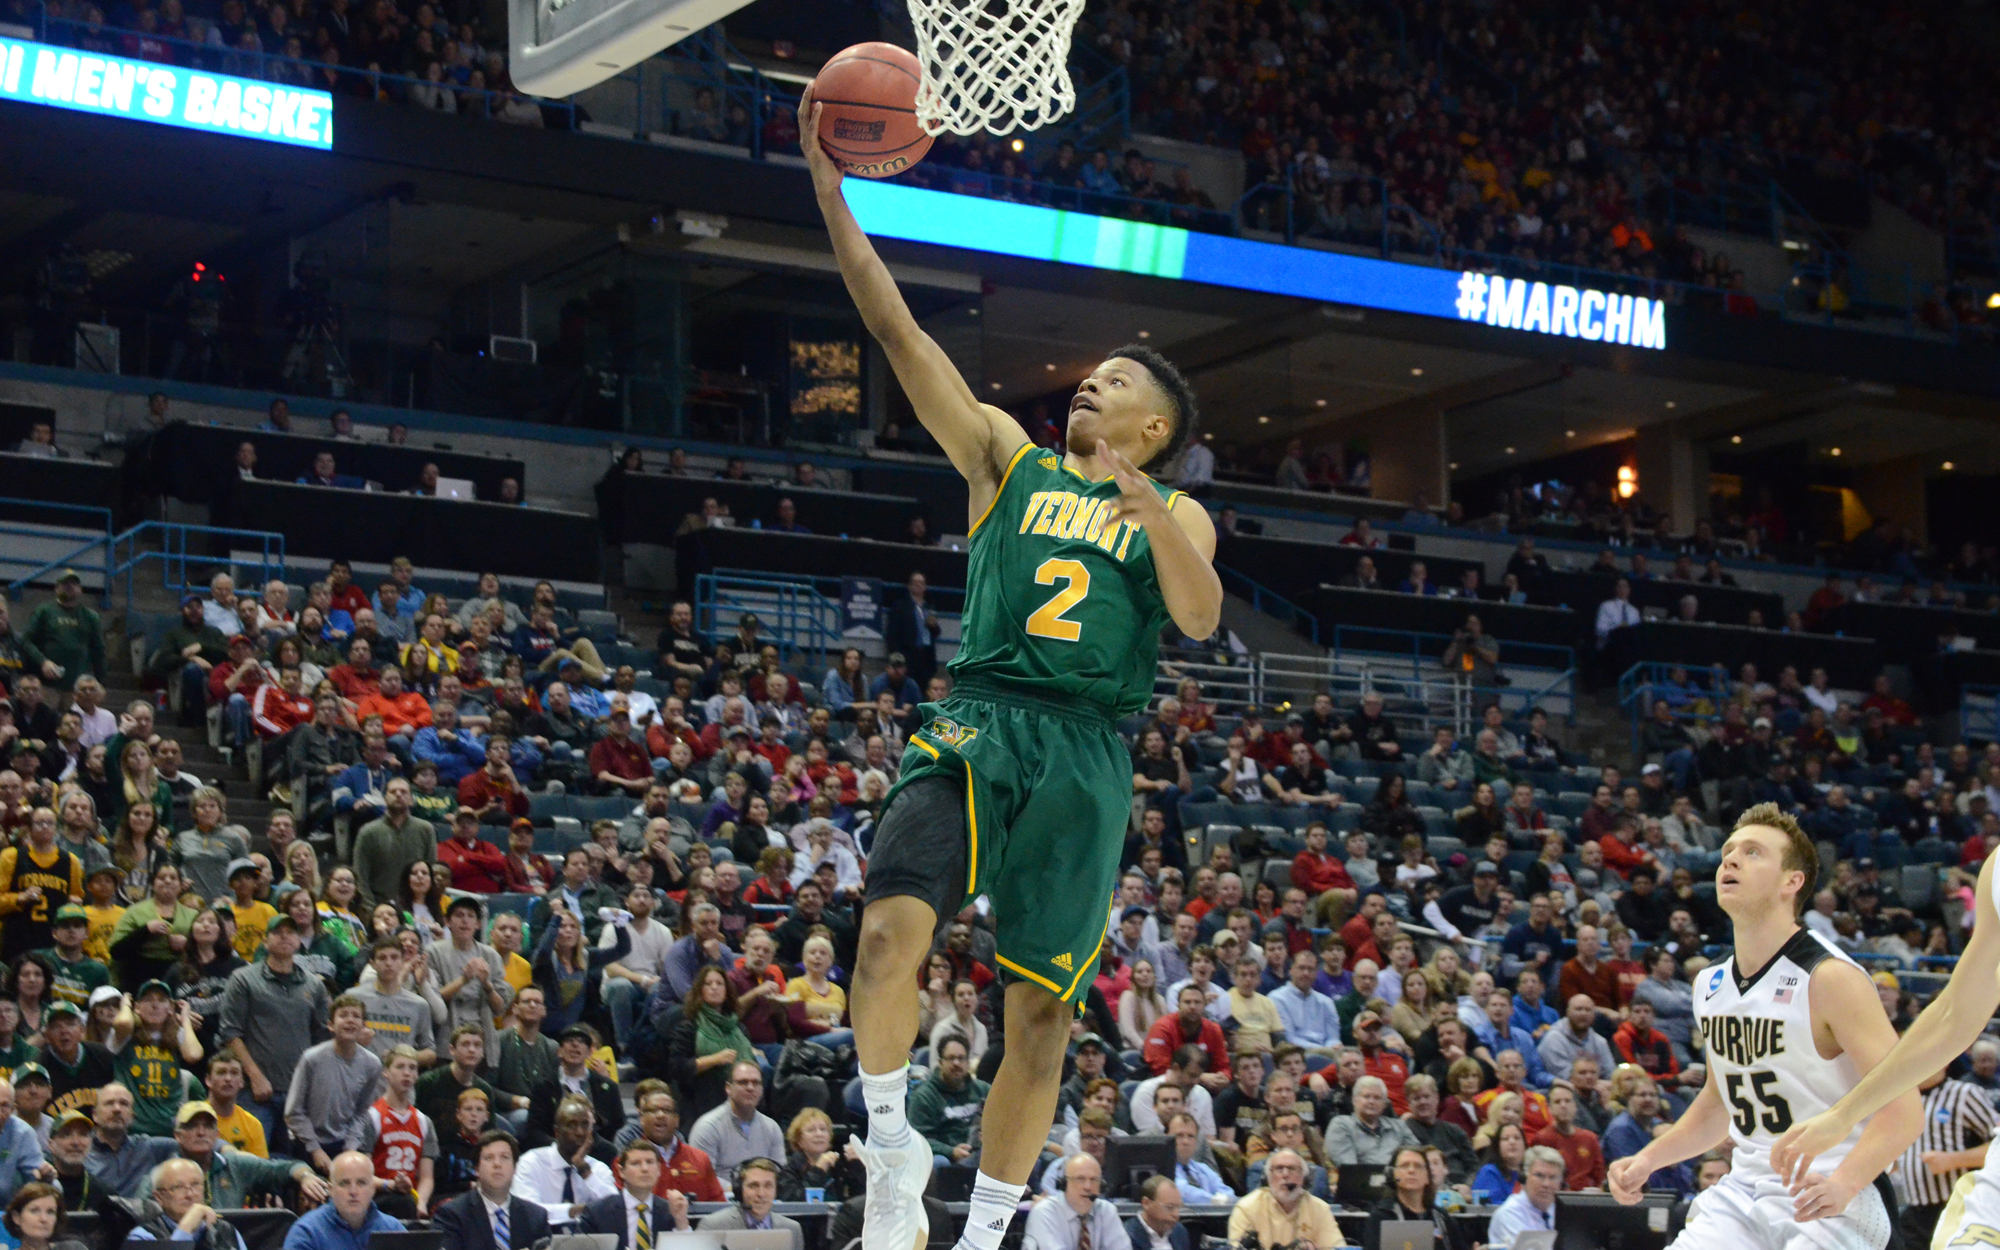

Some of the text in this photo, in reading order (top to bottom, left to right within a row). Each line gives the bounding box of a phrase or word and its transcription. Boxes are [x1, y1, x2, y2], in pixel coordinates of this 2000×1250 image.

[33, 51, 176, 118] MEN'S
[1456, 270, 1666, 349] #MARCHM
[1018, 490, 1141, 562] VERMONT
[1026, 558, 1091, 642] 2
[364, 1011, 412, 1025] ERMONT
[1700, 1015, 1786, 1067] PURDUE
[1725, 1070, 1794, 1138] 55
[385, 1145, 417, 1172] 22
